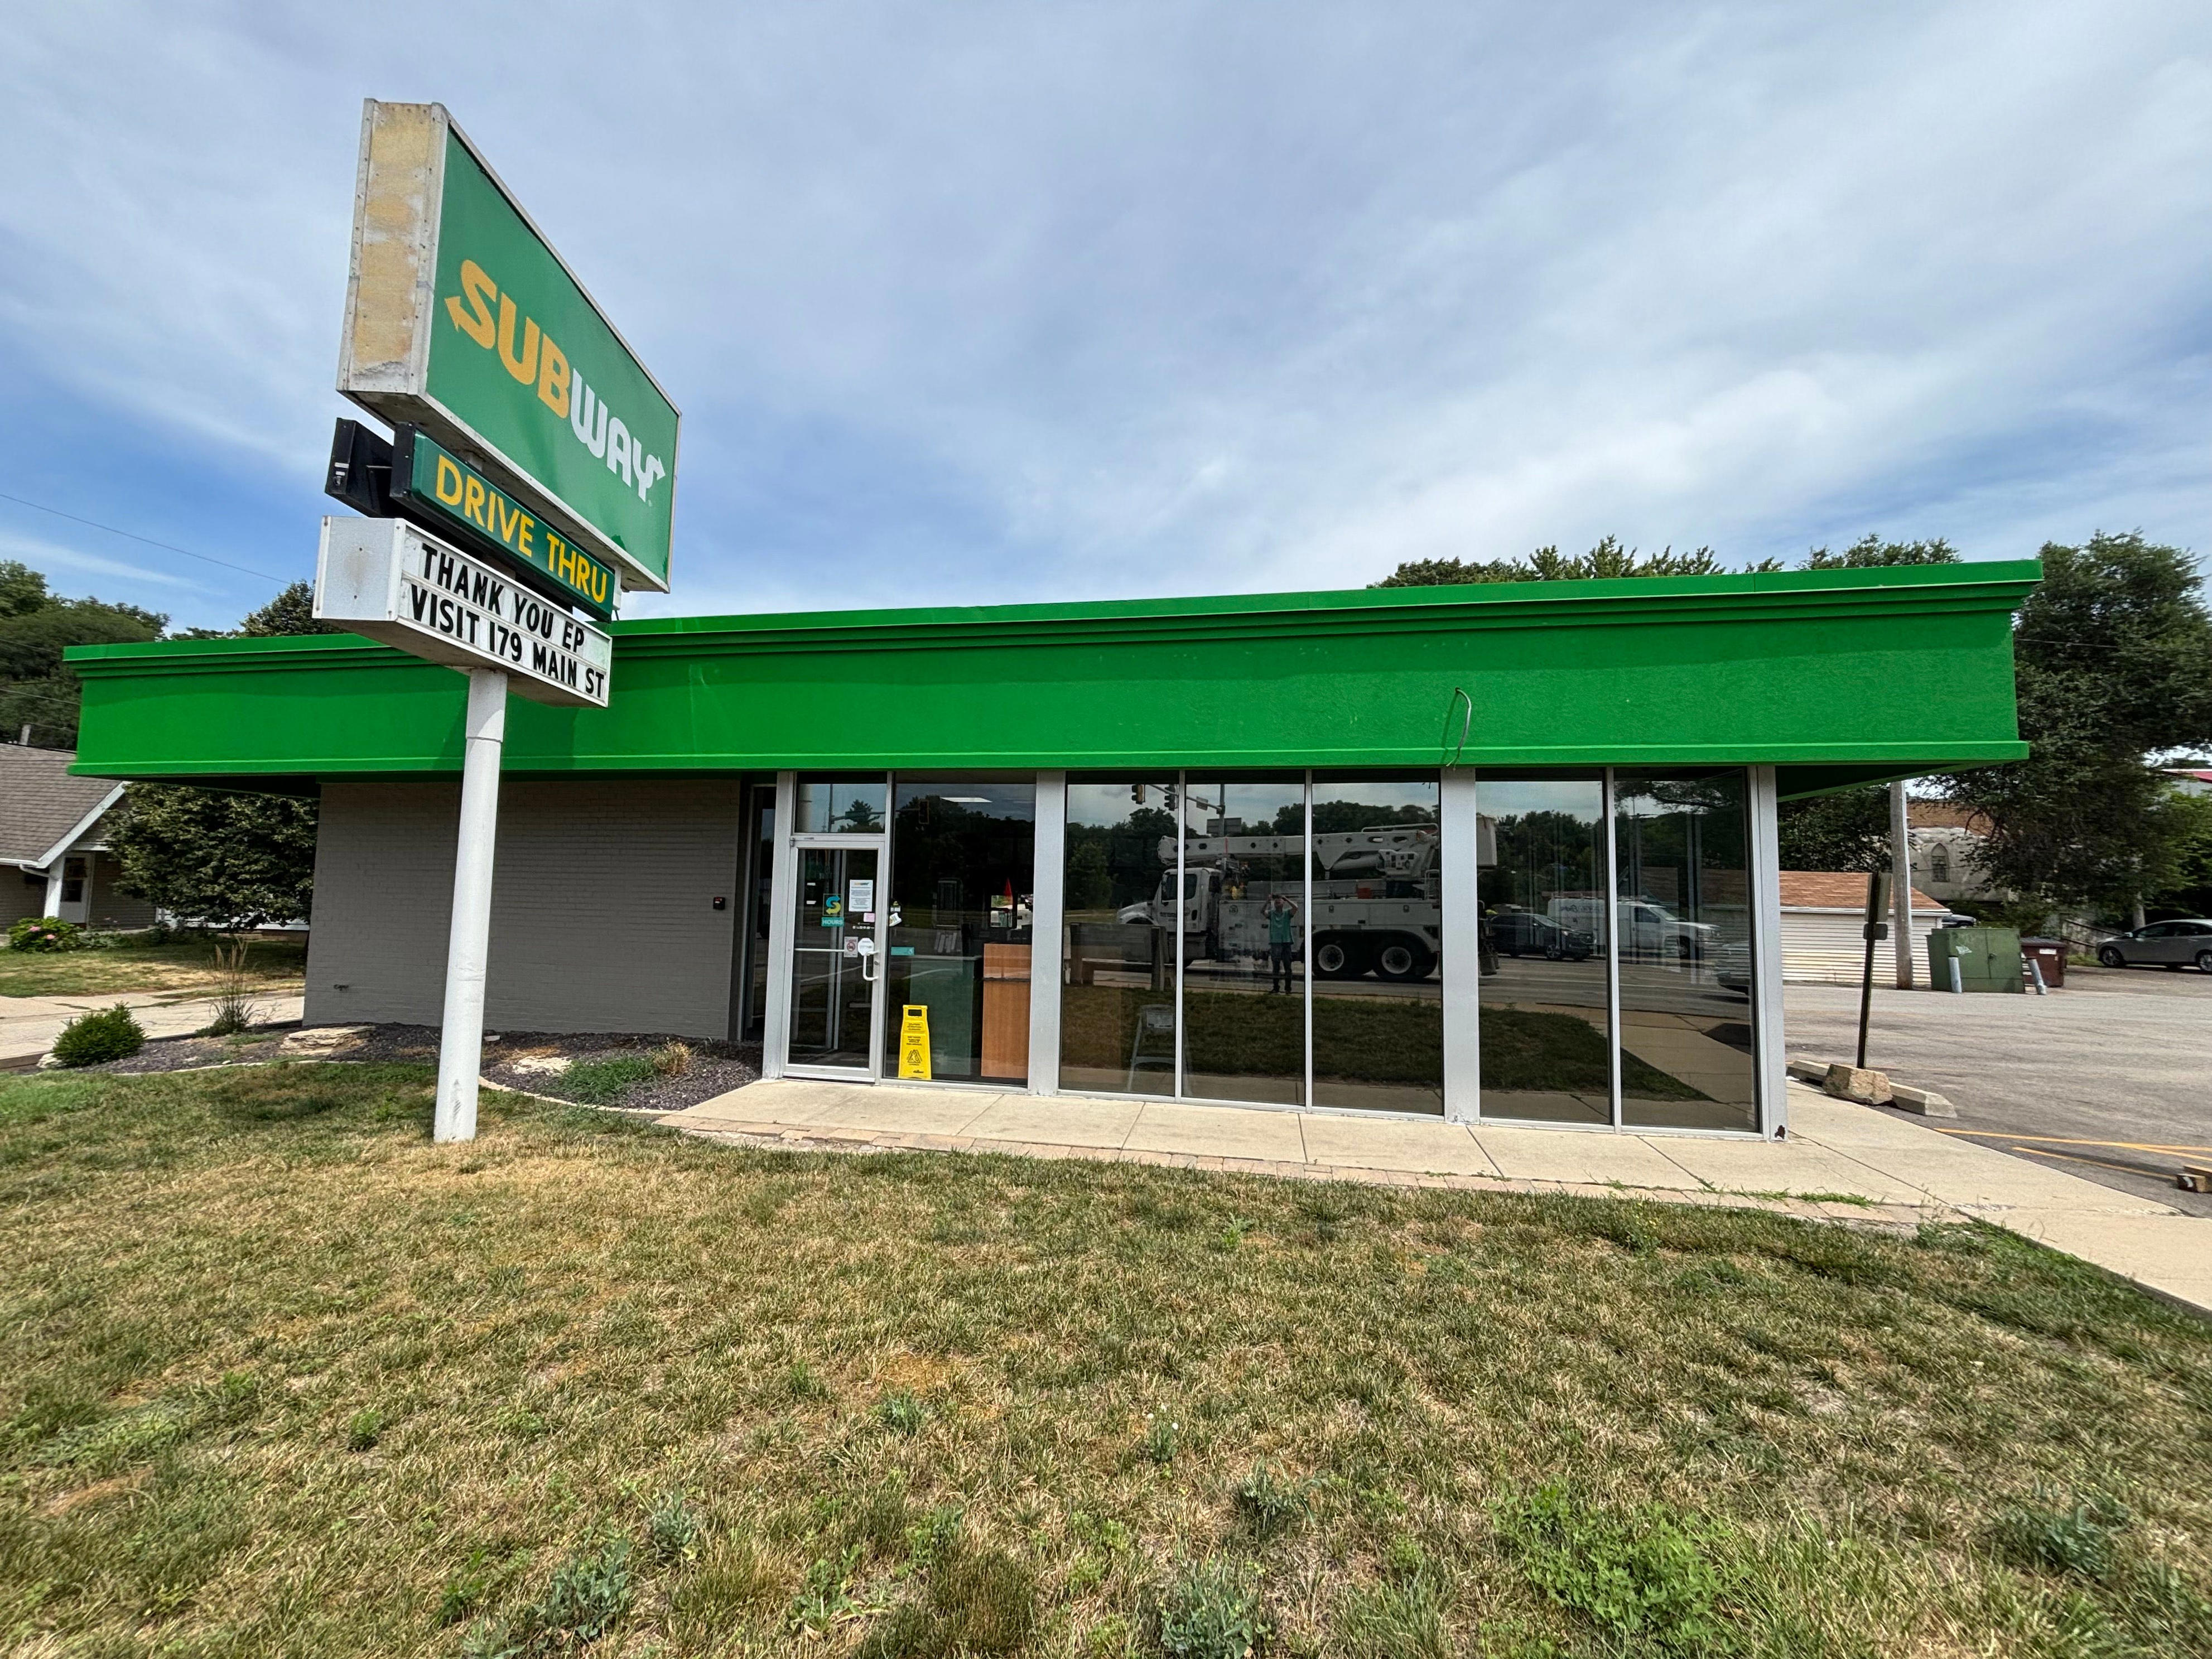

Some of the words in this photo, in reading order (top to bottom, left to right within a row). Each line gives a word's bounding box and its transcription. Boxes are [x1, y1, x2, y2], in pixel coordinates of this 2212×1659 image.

[445, 259, 666, 503] SUBWAY
[436, 454, 534, 557] DRIVE
[547, 532, 607, 603] THRU
[411, 583, 479, 644] VISIT
[489, 621, 522, 662] 179
[533, 642, 577, 687] MAIN
[585, 669, 605, 698] ST
[422, 543, 504, 615] THANK
[515, 592, 553, 639] YOU
[562, 620, 584, 653] EP
